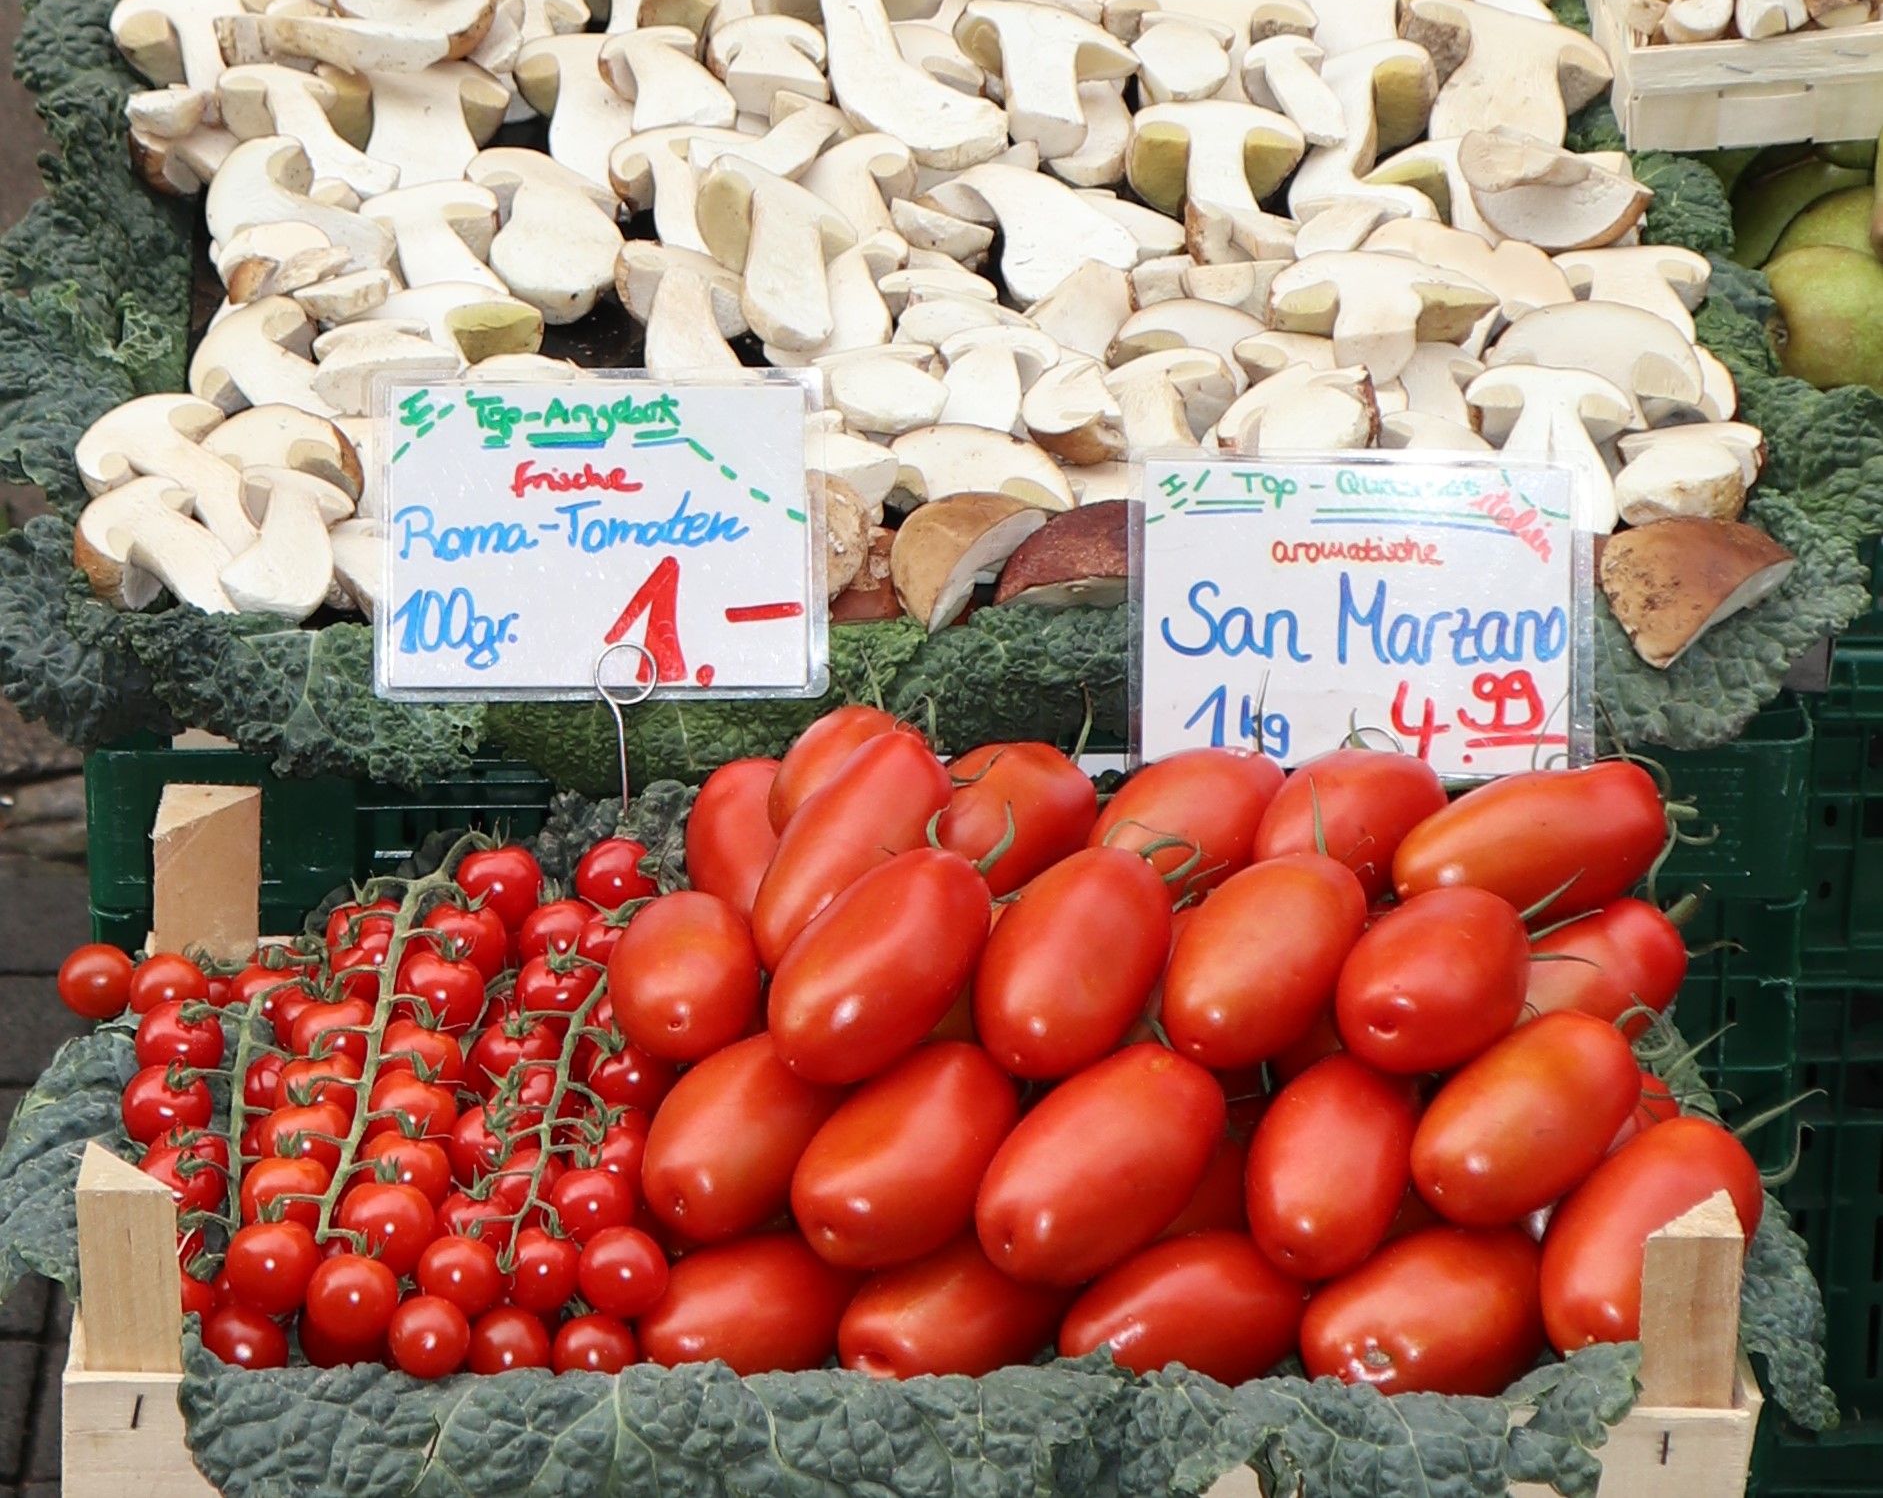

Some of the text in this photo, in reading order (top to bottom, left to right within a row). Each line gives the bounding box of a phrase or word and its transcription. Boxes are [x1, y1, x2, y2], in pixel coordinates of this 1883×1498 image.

[1232, 471, 1299, 508] Top
[391, 586, 520, 670] 100gr.
[1160, 571, 1568, 666] San Marzano
